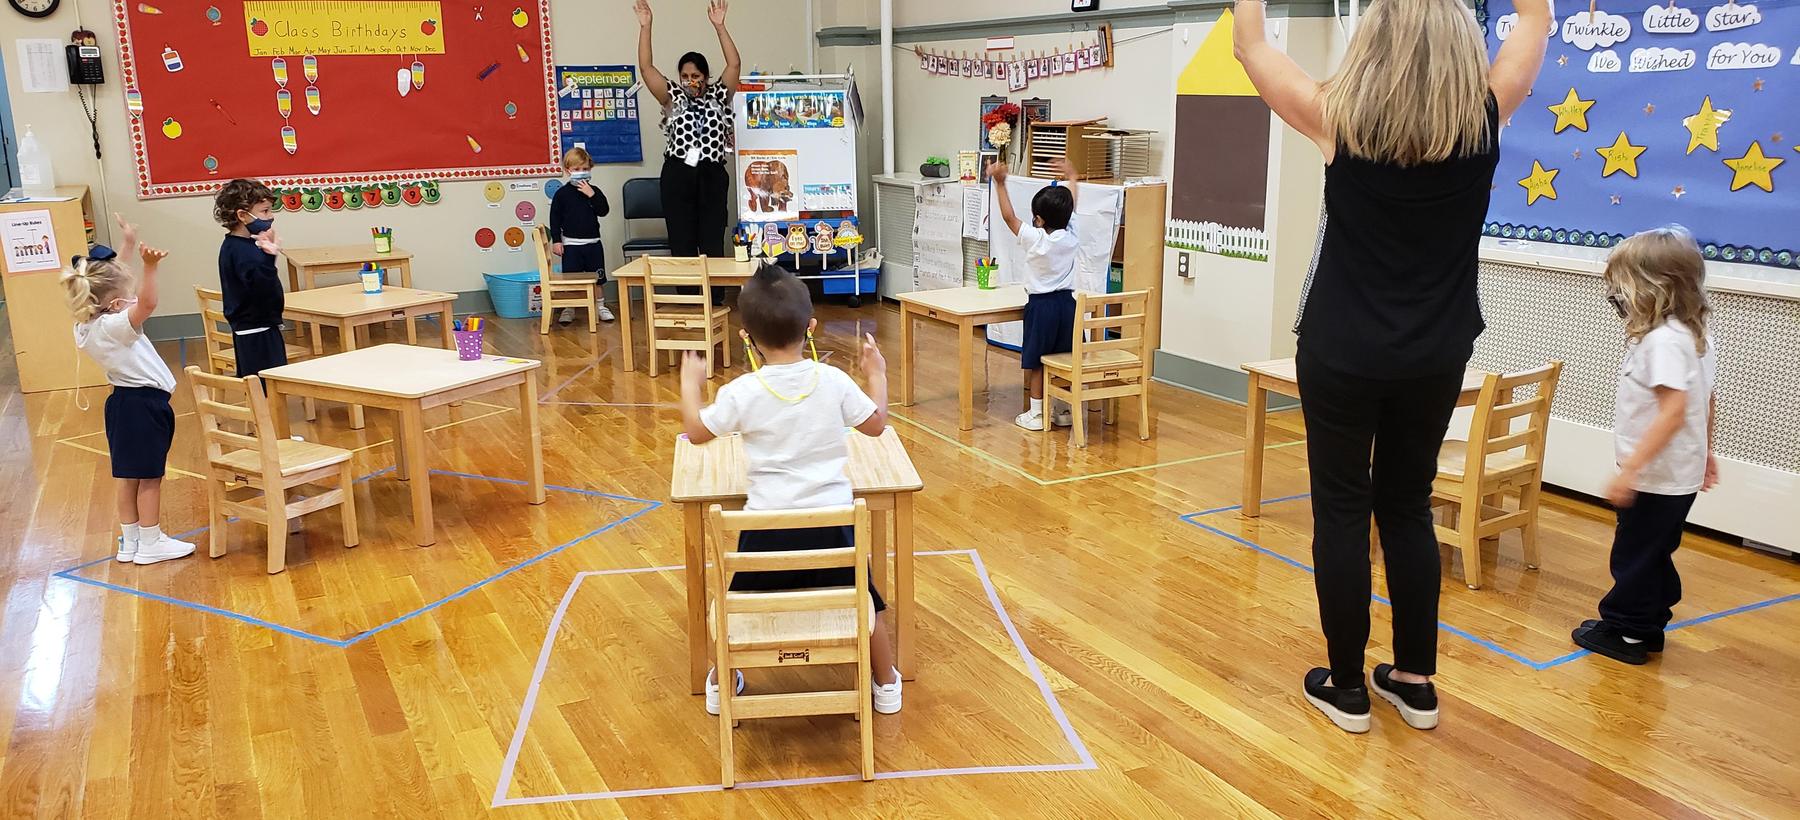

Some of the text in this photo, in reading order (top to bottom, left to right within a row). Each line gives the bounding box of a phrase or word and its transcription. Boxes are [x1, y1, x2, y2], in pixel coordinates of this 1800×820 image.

[274, 20, 407, 42] Class Birthdays
[1566, 22, 1626, 37] Twinkle
[1648, 13, 1694, 28] Little
[1713, 12, 1755, 27] Star,
[289, 46, 301, 54] Mar
[304, 47, 316, 55] Apr
[349, 45, 360, 53] Jul
[1595, 49, 1776, 70] We Wished for You
[573, 74, 632, 85] September
[290, 188, 436, 205] 3 4 5 6 7 8 9 10
